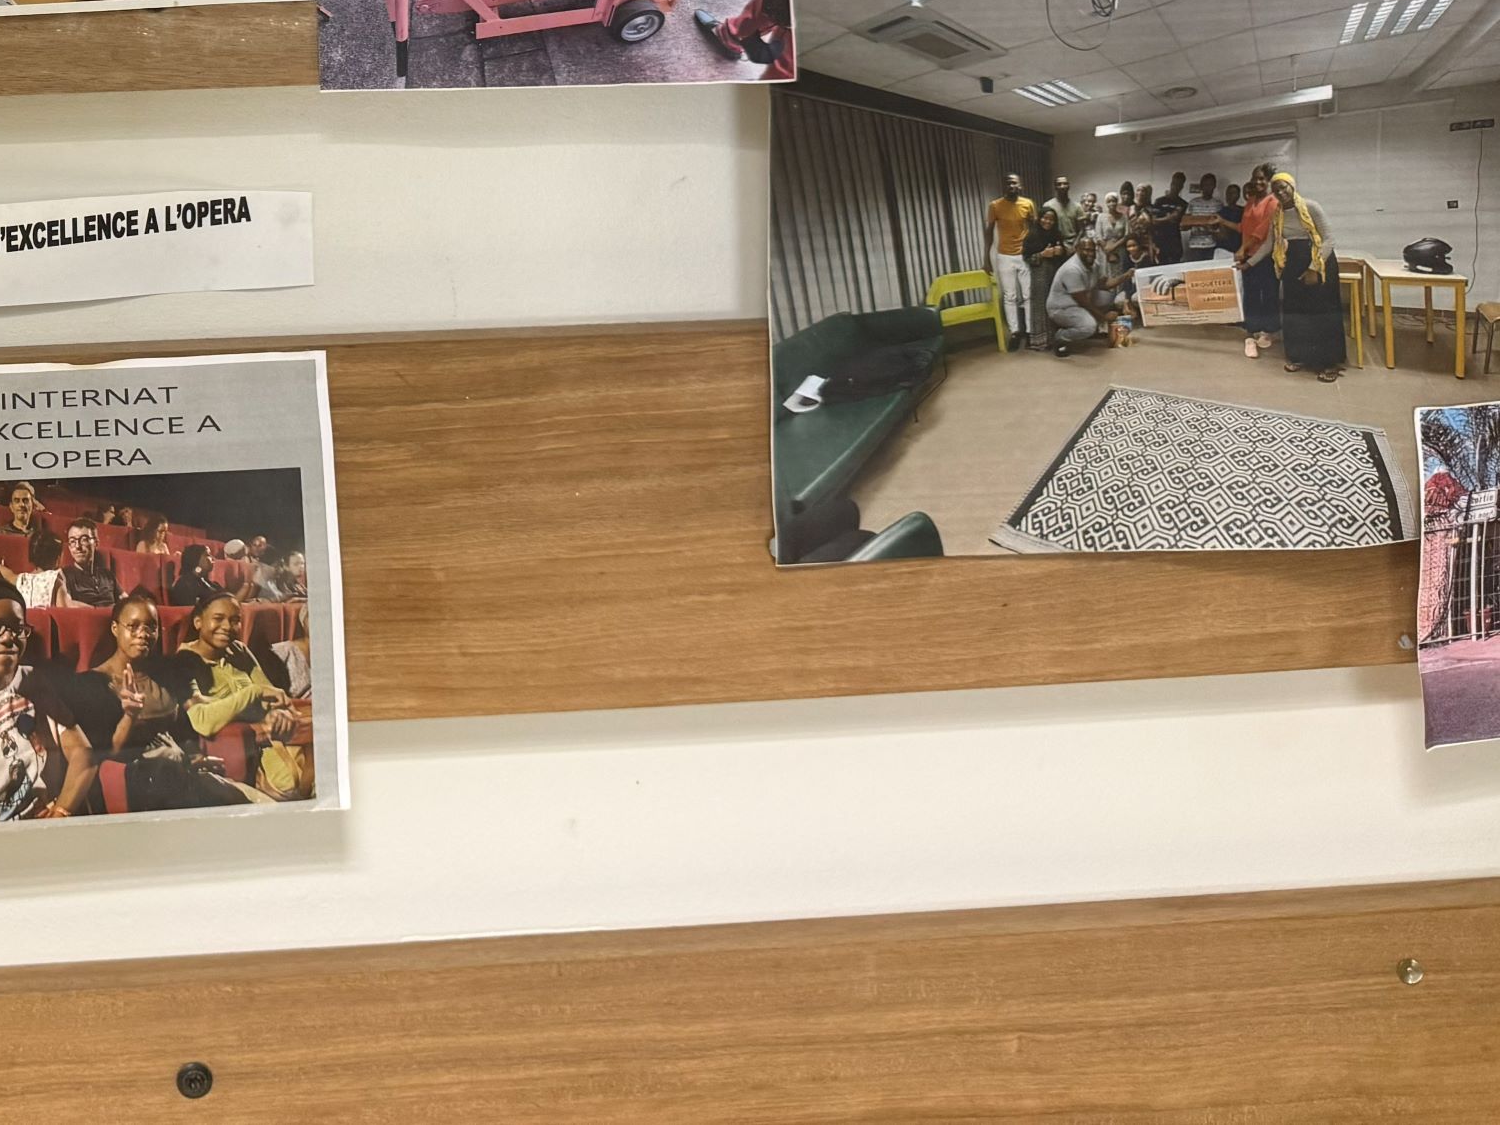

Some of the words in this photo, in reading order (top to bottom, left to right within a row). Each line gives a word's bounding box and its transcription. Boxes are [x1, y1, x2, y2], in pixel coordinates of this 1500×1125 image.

[144, 207, 160, 235] A
[165, 196, 252, 232] L'OPERA
[196, 414, 222, 433] A
[5, 447, 152, 471] L'OPERA
